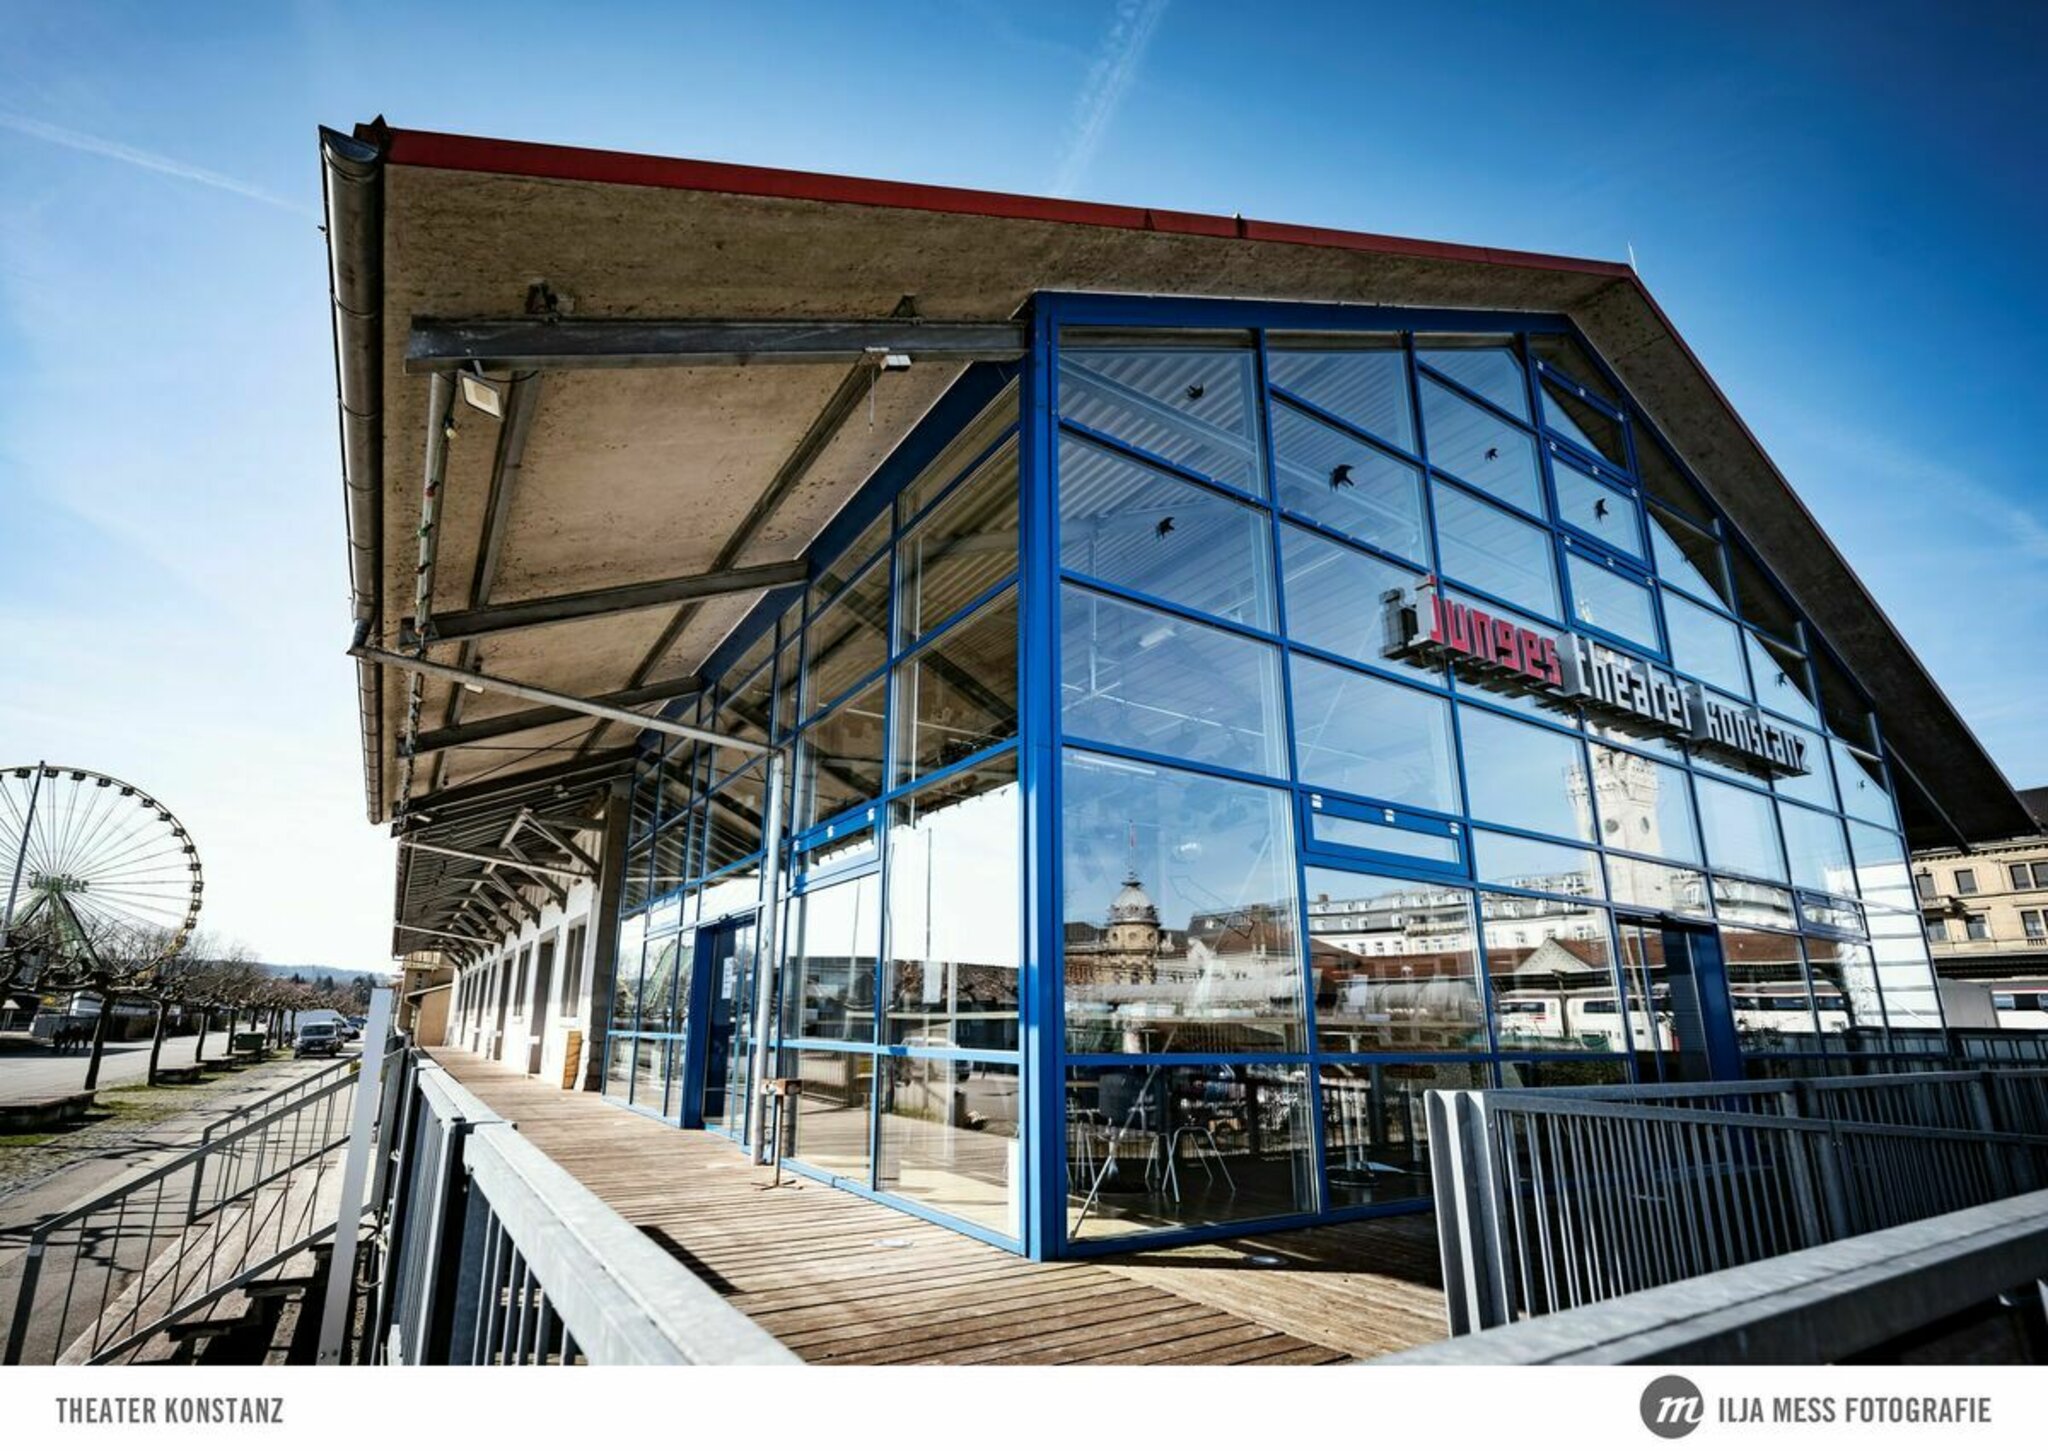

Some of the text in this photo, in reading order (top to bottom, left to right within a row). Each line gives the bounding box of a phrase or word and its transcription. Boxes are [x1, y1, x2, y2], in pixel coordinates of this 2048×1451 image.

[1413, 575, 1809, 772] junges theater konstanz
